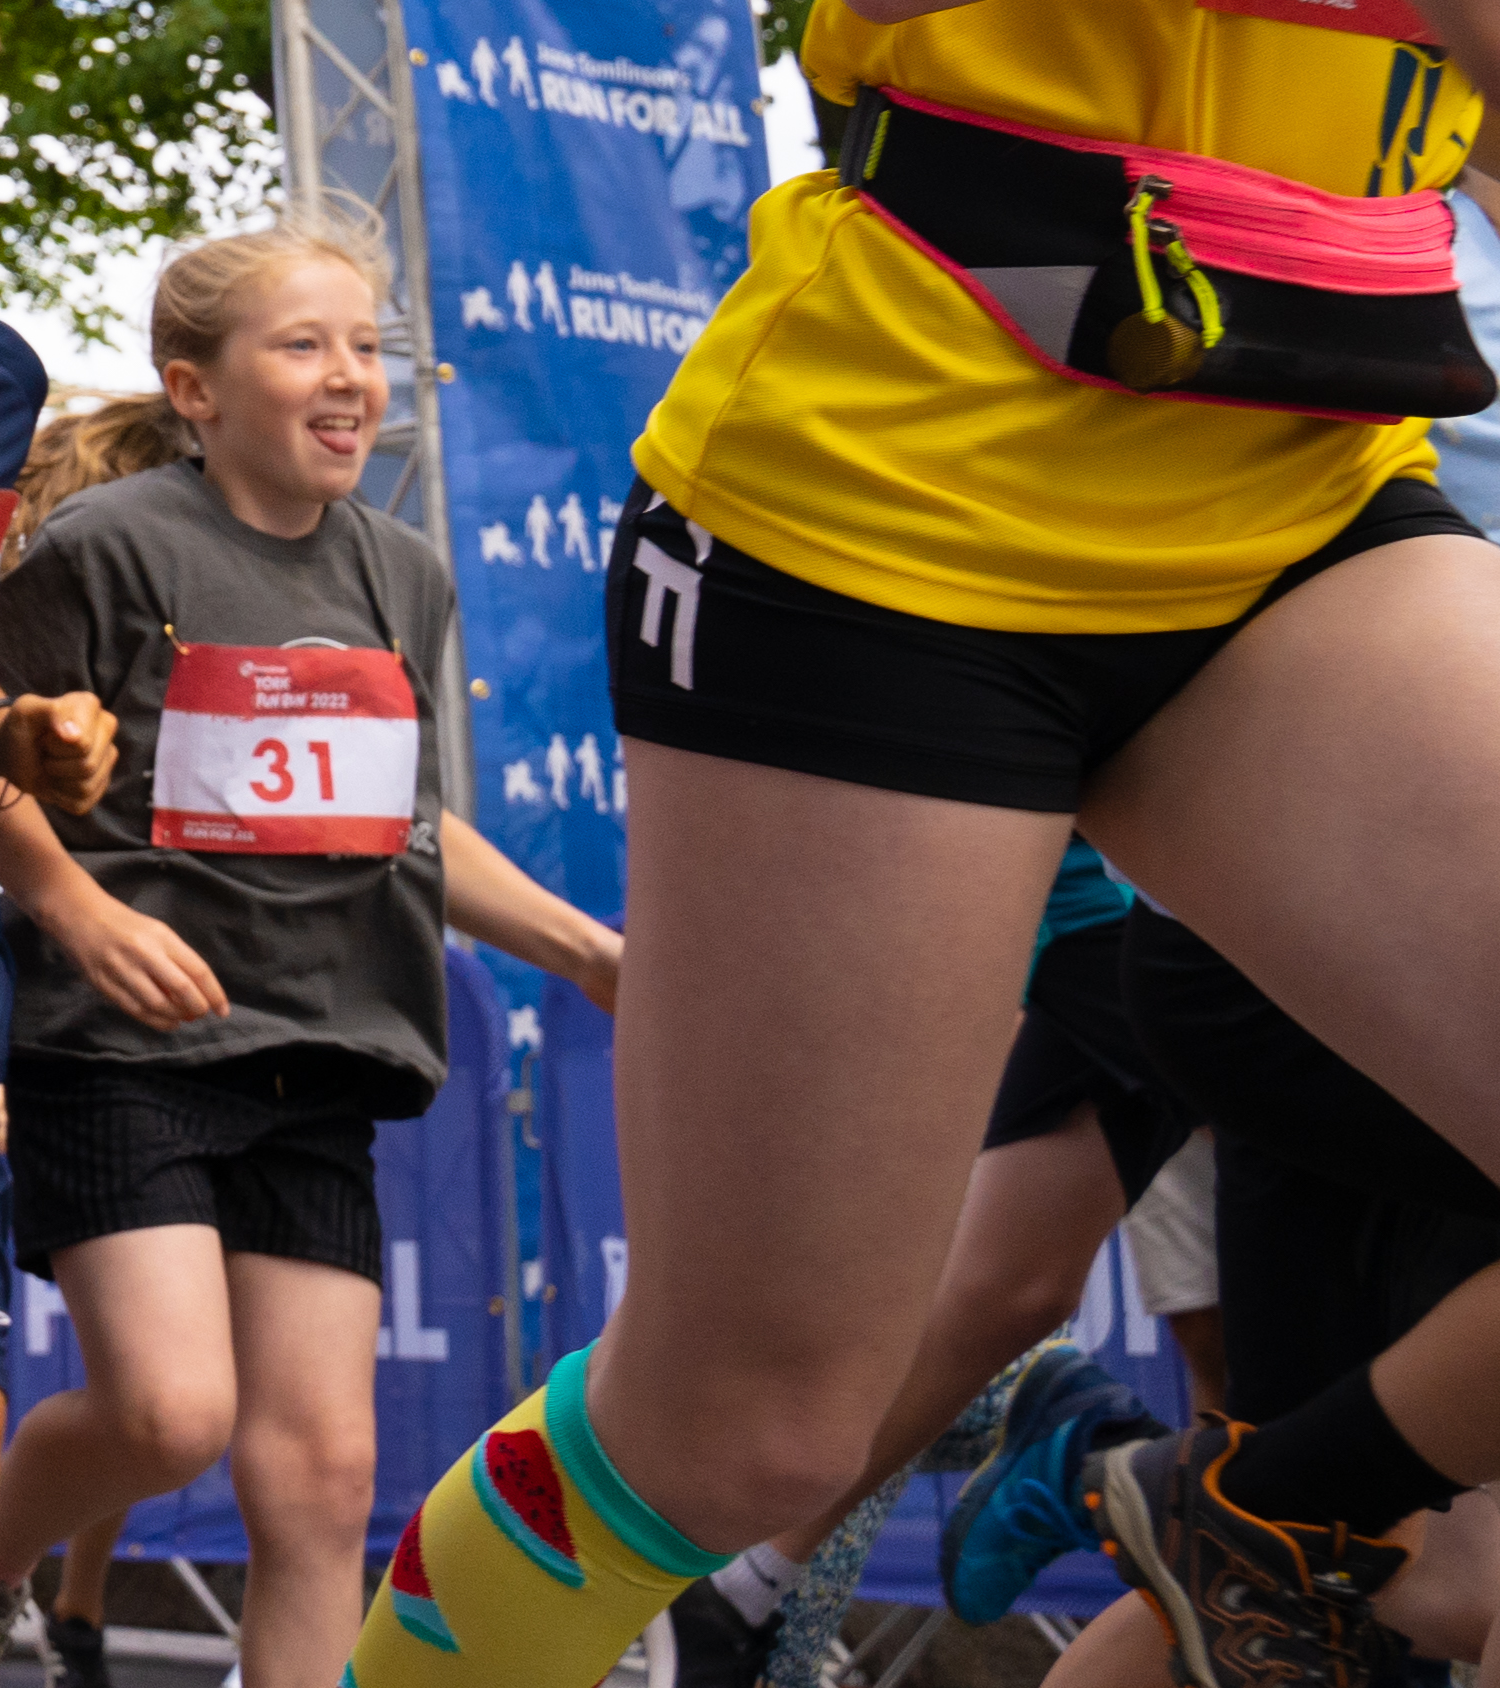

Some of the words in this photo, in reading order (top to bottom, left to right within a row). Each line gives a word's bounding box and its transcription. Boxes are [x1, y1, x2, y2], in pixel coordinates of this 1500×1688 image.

[539, 69, 607, 122] RUN
[610, 86, 683, 138] FOR
[690, 101, 750, 147] ALL
[569, 296, 647, 348] RUN
[249, 737, 336, 803] 31
